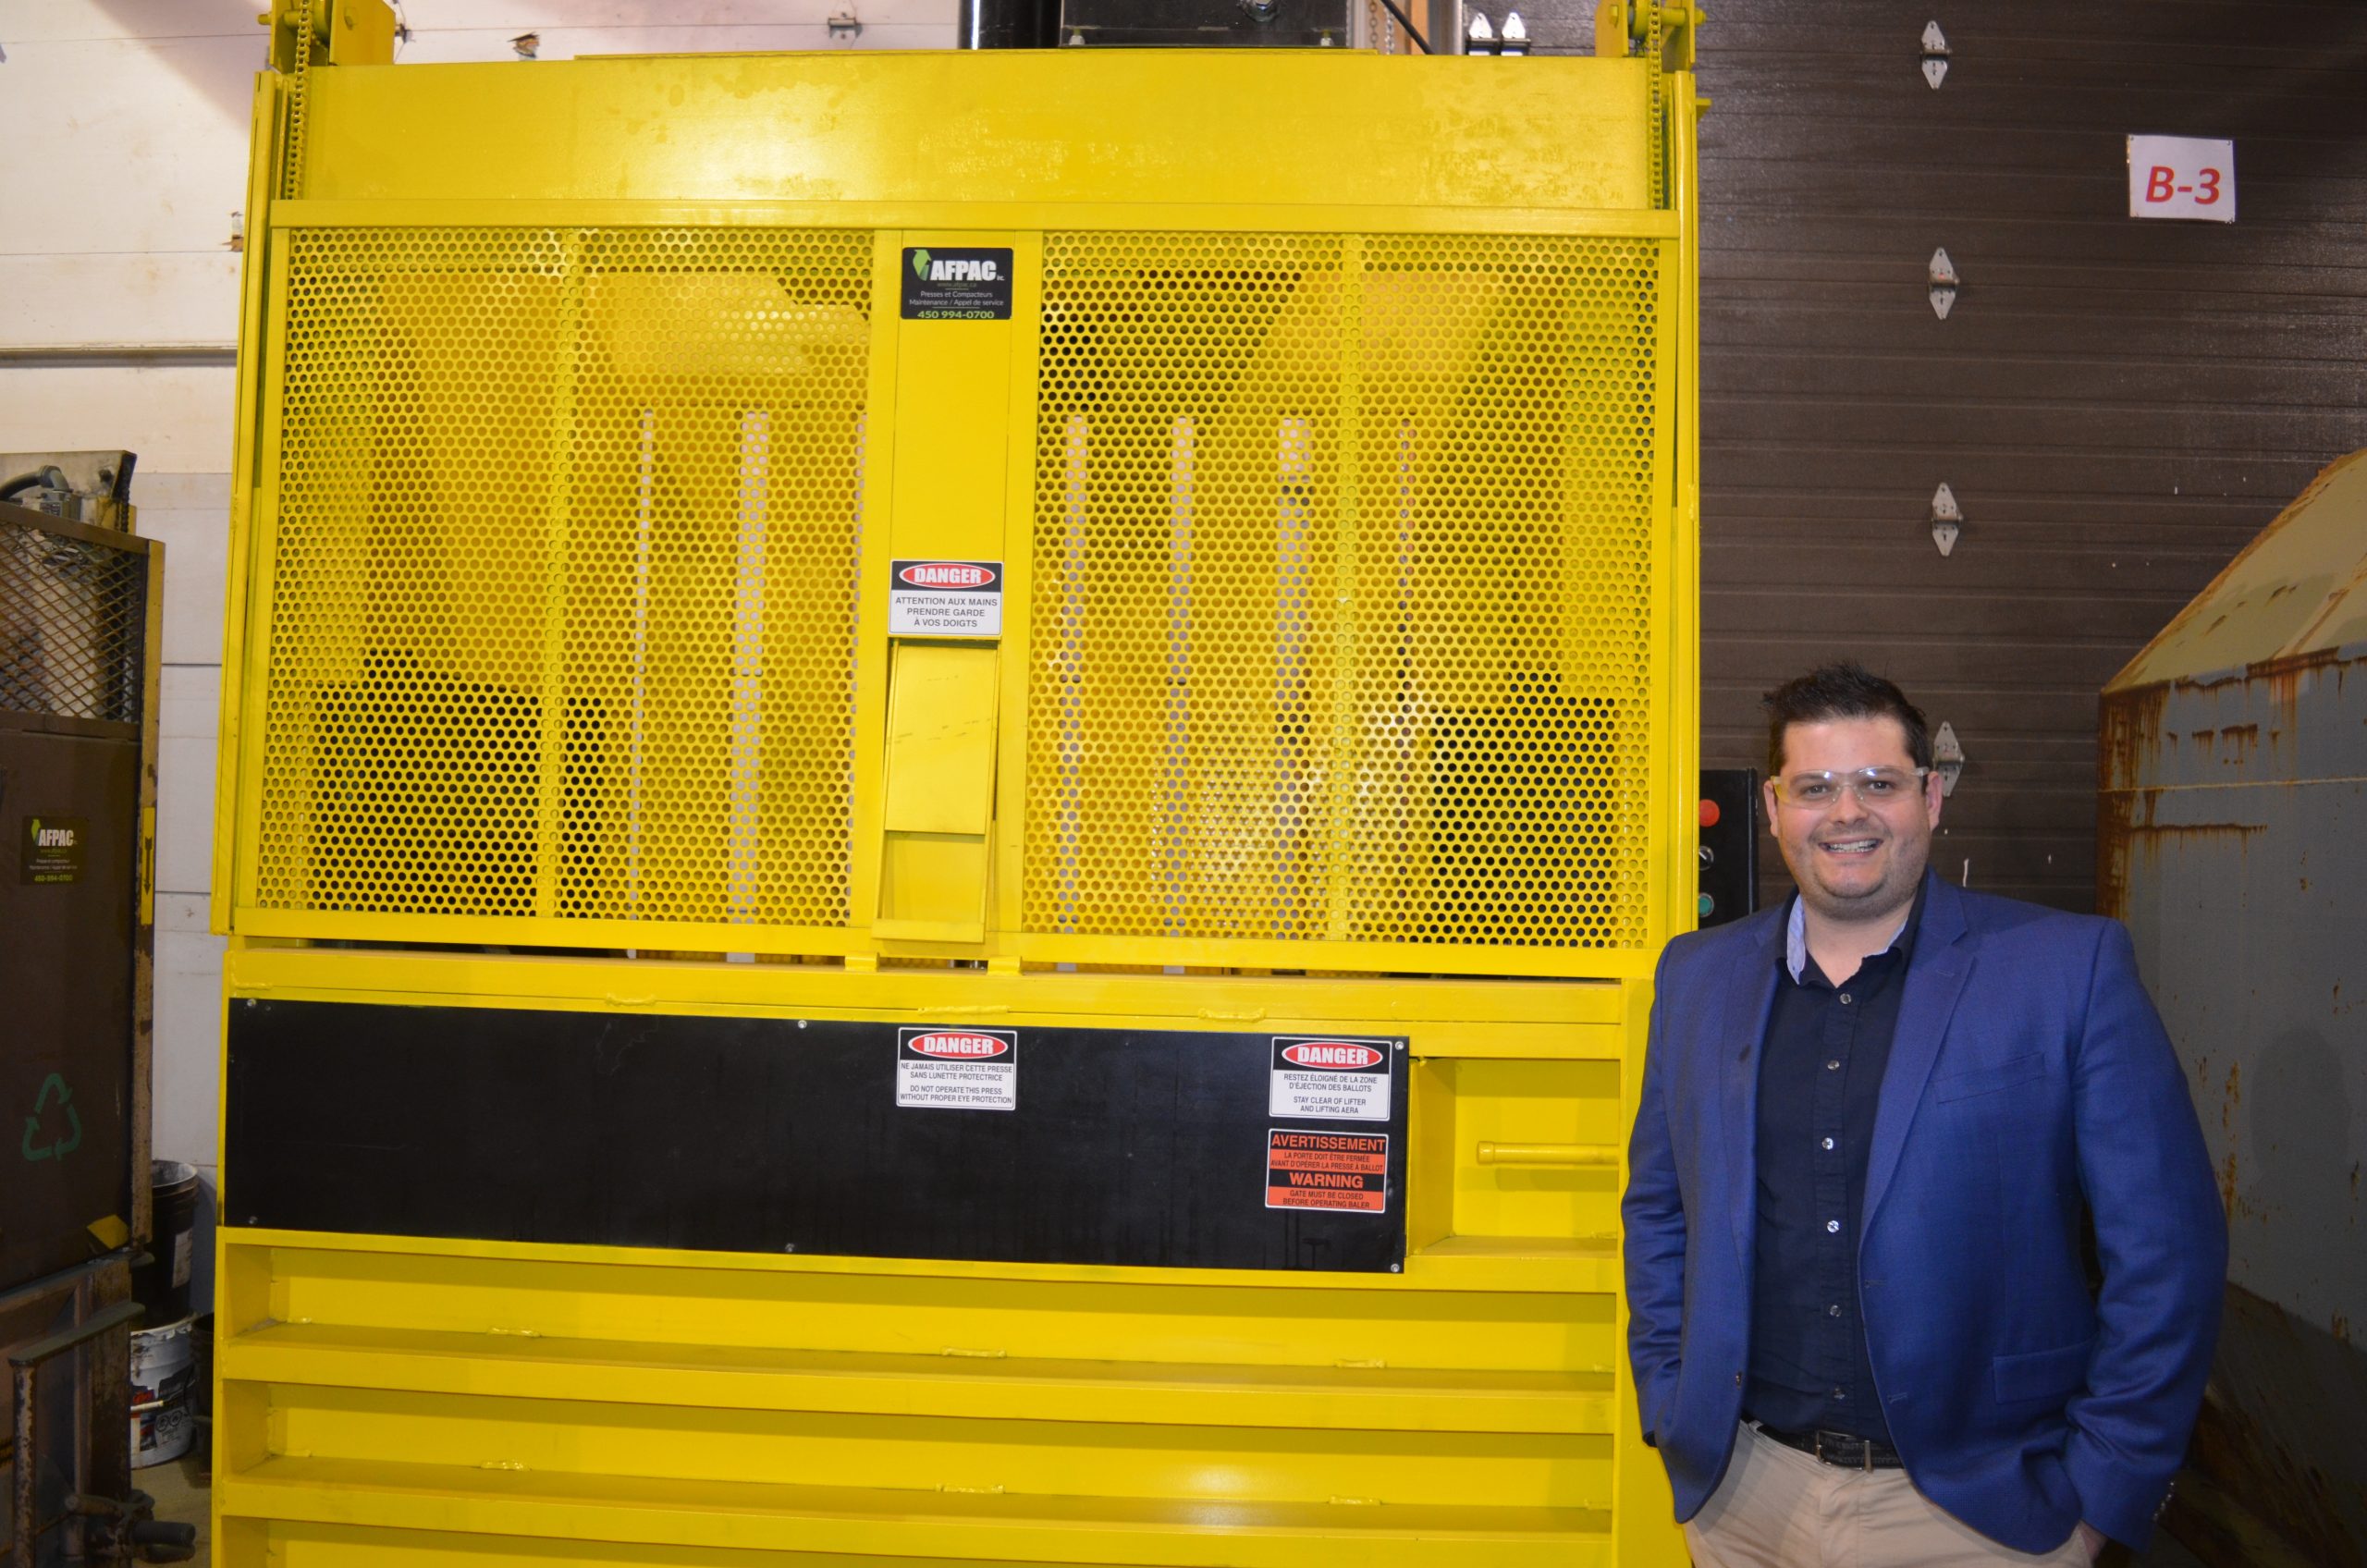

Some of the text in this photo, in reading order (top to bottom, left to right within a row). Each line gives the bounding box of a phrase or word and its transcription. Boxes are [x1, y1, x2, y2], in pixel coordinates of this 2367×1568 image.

[2146, 165, 2220, 204] B-3
[930, 261, 997, 281] AFPAC
[954, 300, 971, 308] Appel
[941, 311, 994, 319] 994-0700
[914, 568, 981, 583] DANGER
[907, 607, 950, 616] PRENDRE
[914, 618, 920, 626] À
[39, 829, 74, 846] AFPAC
[924, 1037, 993, 1054] DANGER
[1297, 1047, 1367, 1064] DANGER
[1310, 1073, 1337, 1083] ÉLOIGNÉ
[1290, 1082, 1326, 1090] D'ÉJECTION
[1272, 1133, 1385, 1151] AVERTISSEMENT
[1291, 1160, 1319, 1169] D'OPÉRER
[1290, 1172, 1363, 1189] WARNING
